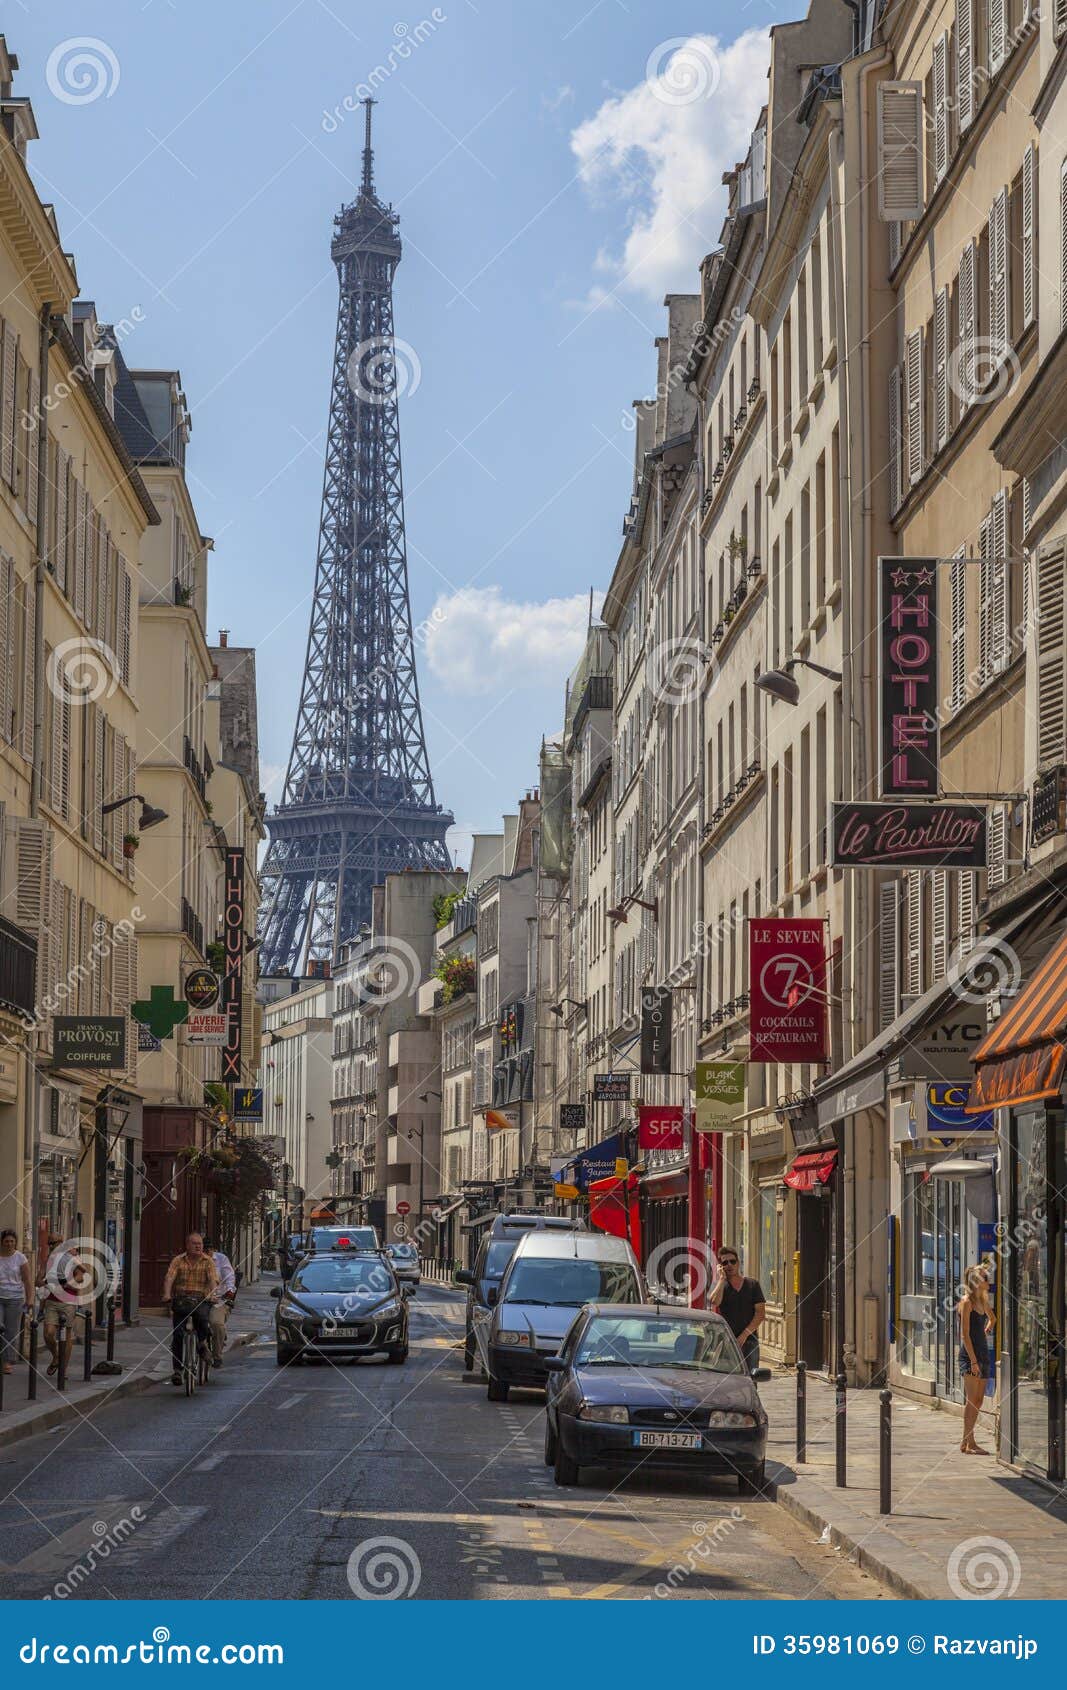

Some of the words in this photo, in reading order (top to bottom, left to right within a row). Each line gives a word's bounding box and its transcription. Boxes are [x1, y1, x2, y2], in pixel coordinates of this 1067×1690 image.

[890, 595, 930, 787] HOTEL
[871, 808, 982, 850] Pavillon
[754, 930, 771, 943] LE
[777, 930, 820, 943] SEVEN
[225, 854, 243, 1076] THOUMIEUX
[774, 962, 799, 998] 7
[187, 1015, 225, 1025] LAVERIE
[760, 1017, 814, 1027] COCKTAILS
[57, 1030, 122, 1042] PROVOST
[756, 1032, 819, 1043] RESTAURANT
[66, 1052, 112, 1061] COIFFURE
[706, 1070, 736, 1081] BLANC
[703, 1085, 740, 1094] VOSGES
[930, 1087, 972, 1106] LC
[649, 1120, 682, 1135] SFR
